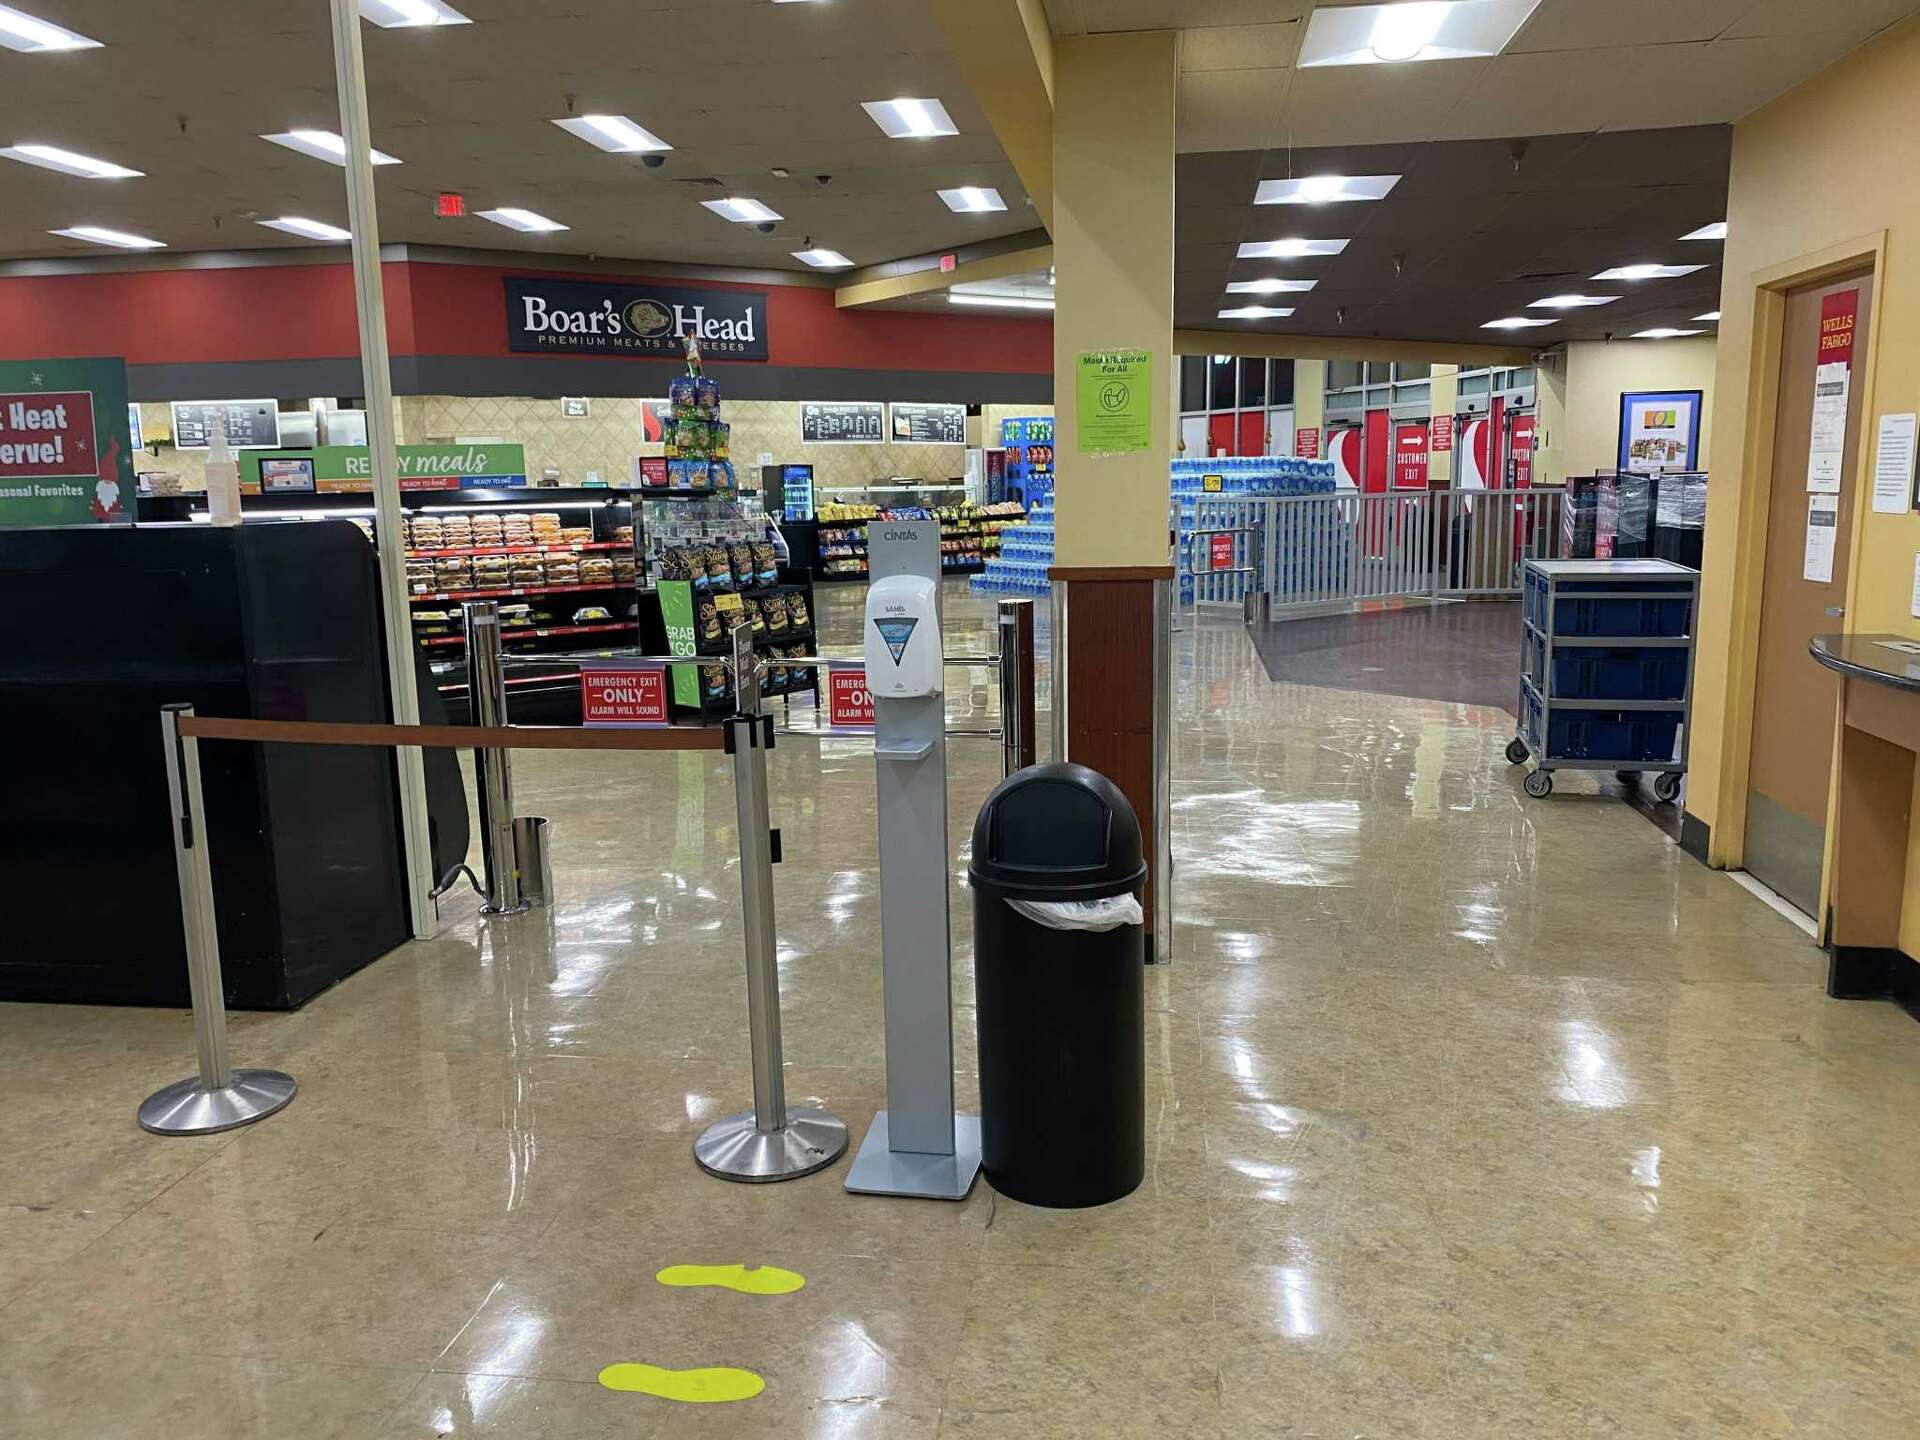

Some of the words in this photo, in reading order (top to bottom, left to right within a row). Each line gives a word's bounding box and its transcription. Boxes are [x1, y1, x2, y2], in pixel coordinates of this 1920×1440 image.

[522, 296, 621, 334] Boar's
[672, 304, 755, 341] Head
[1823, 315, 1853, 332] WELLS
[538, 335, 606, 346] PREMIUM
[614, 339, 661, 348] MEATS
[668, 341, 675, 349] &
[699, 342, 745, 351] EESES
[1821, 333, 1852, 350] FARGO
[9, 402, 68, 431] Heat
[0, 435, 65, 464] erve!
[345, 456, 411, 474] REY
[416, 447, 488, 473] meals
[1397, 453, 1427, 464] CUSTOMER
[1405, 469, 1418, 480] EXIT
[34, 484, 84, 497] Favorites
[665, 626, 695, 640] GRAB
[588, 677, 637, 687] EMERGENCY
[640, 677, 657, 687] EXIT
[603, 688, 644, 703] ONLY
[591, 706, 615, 715] ALARM
[617, 706, 634, 715] WILL
[636, 706, 660, 715] SOUND
[837, 709, 862, 718] ALARM
